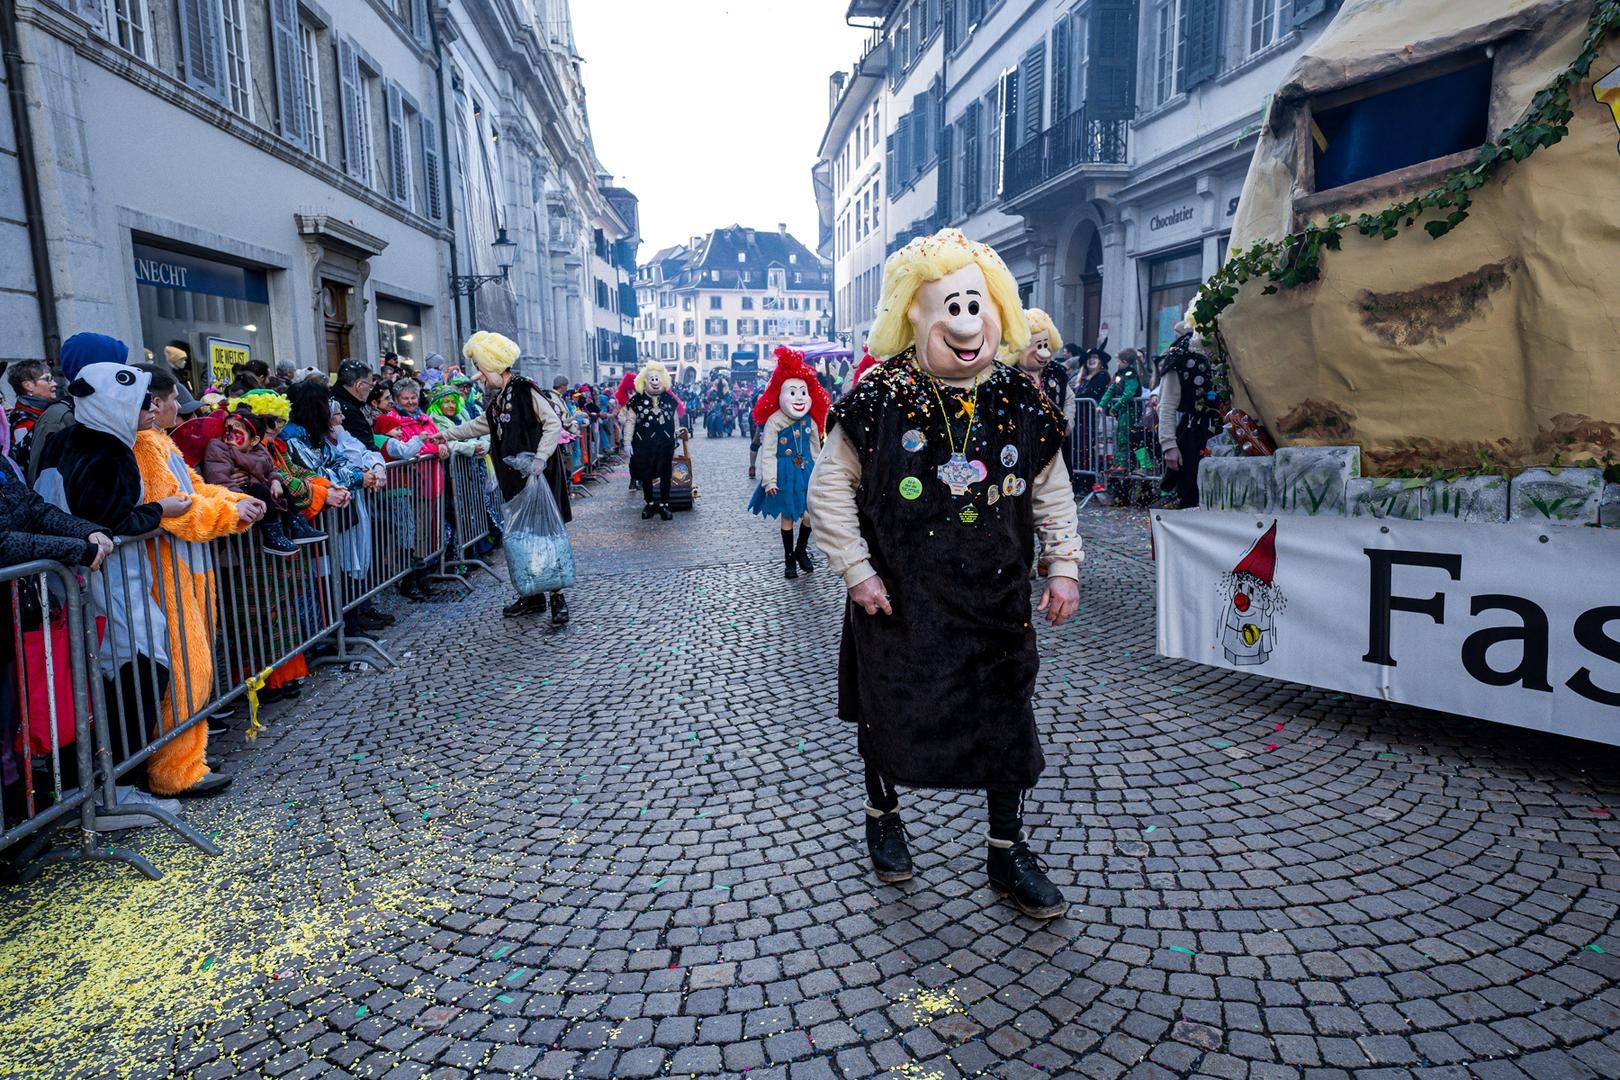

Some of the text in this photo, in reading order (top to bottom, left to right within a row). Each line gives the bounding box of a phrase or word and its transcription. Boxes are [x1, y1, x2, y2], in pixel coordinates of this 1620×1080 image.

[1150, 205, 1194, 231] Chocolatier
[215, 348, 224, 364] DIE
[224, 350, 237, 366] WELT
[1362, 548, 1620, 707] Fas
